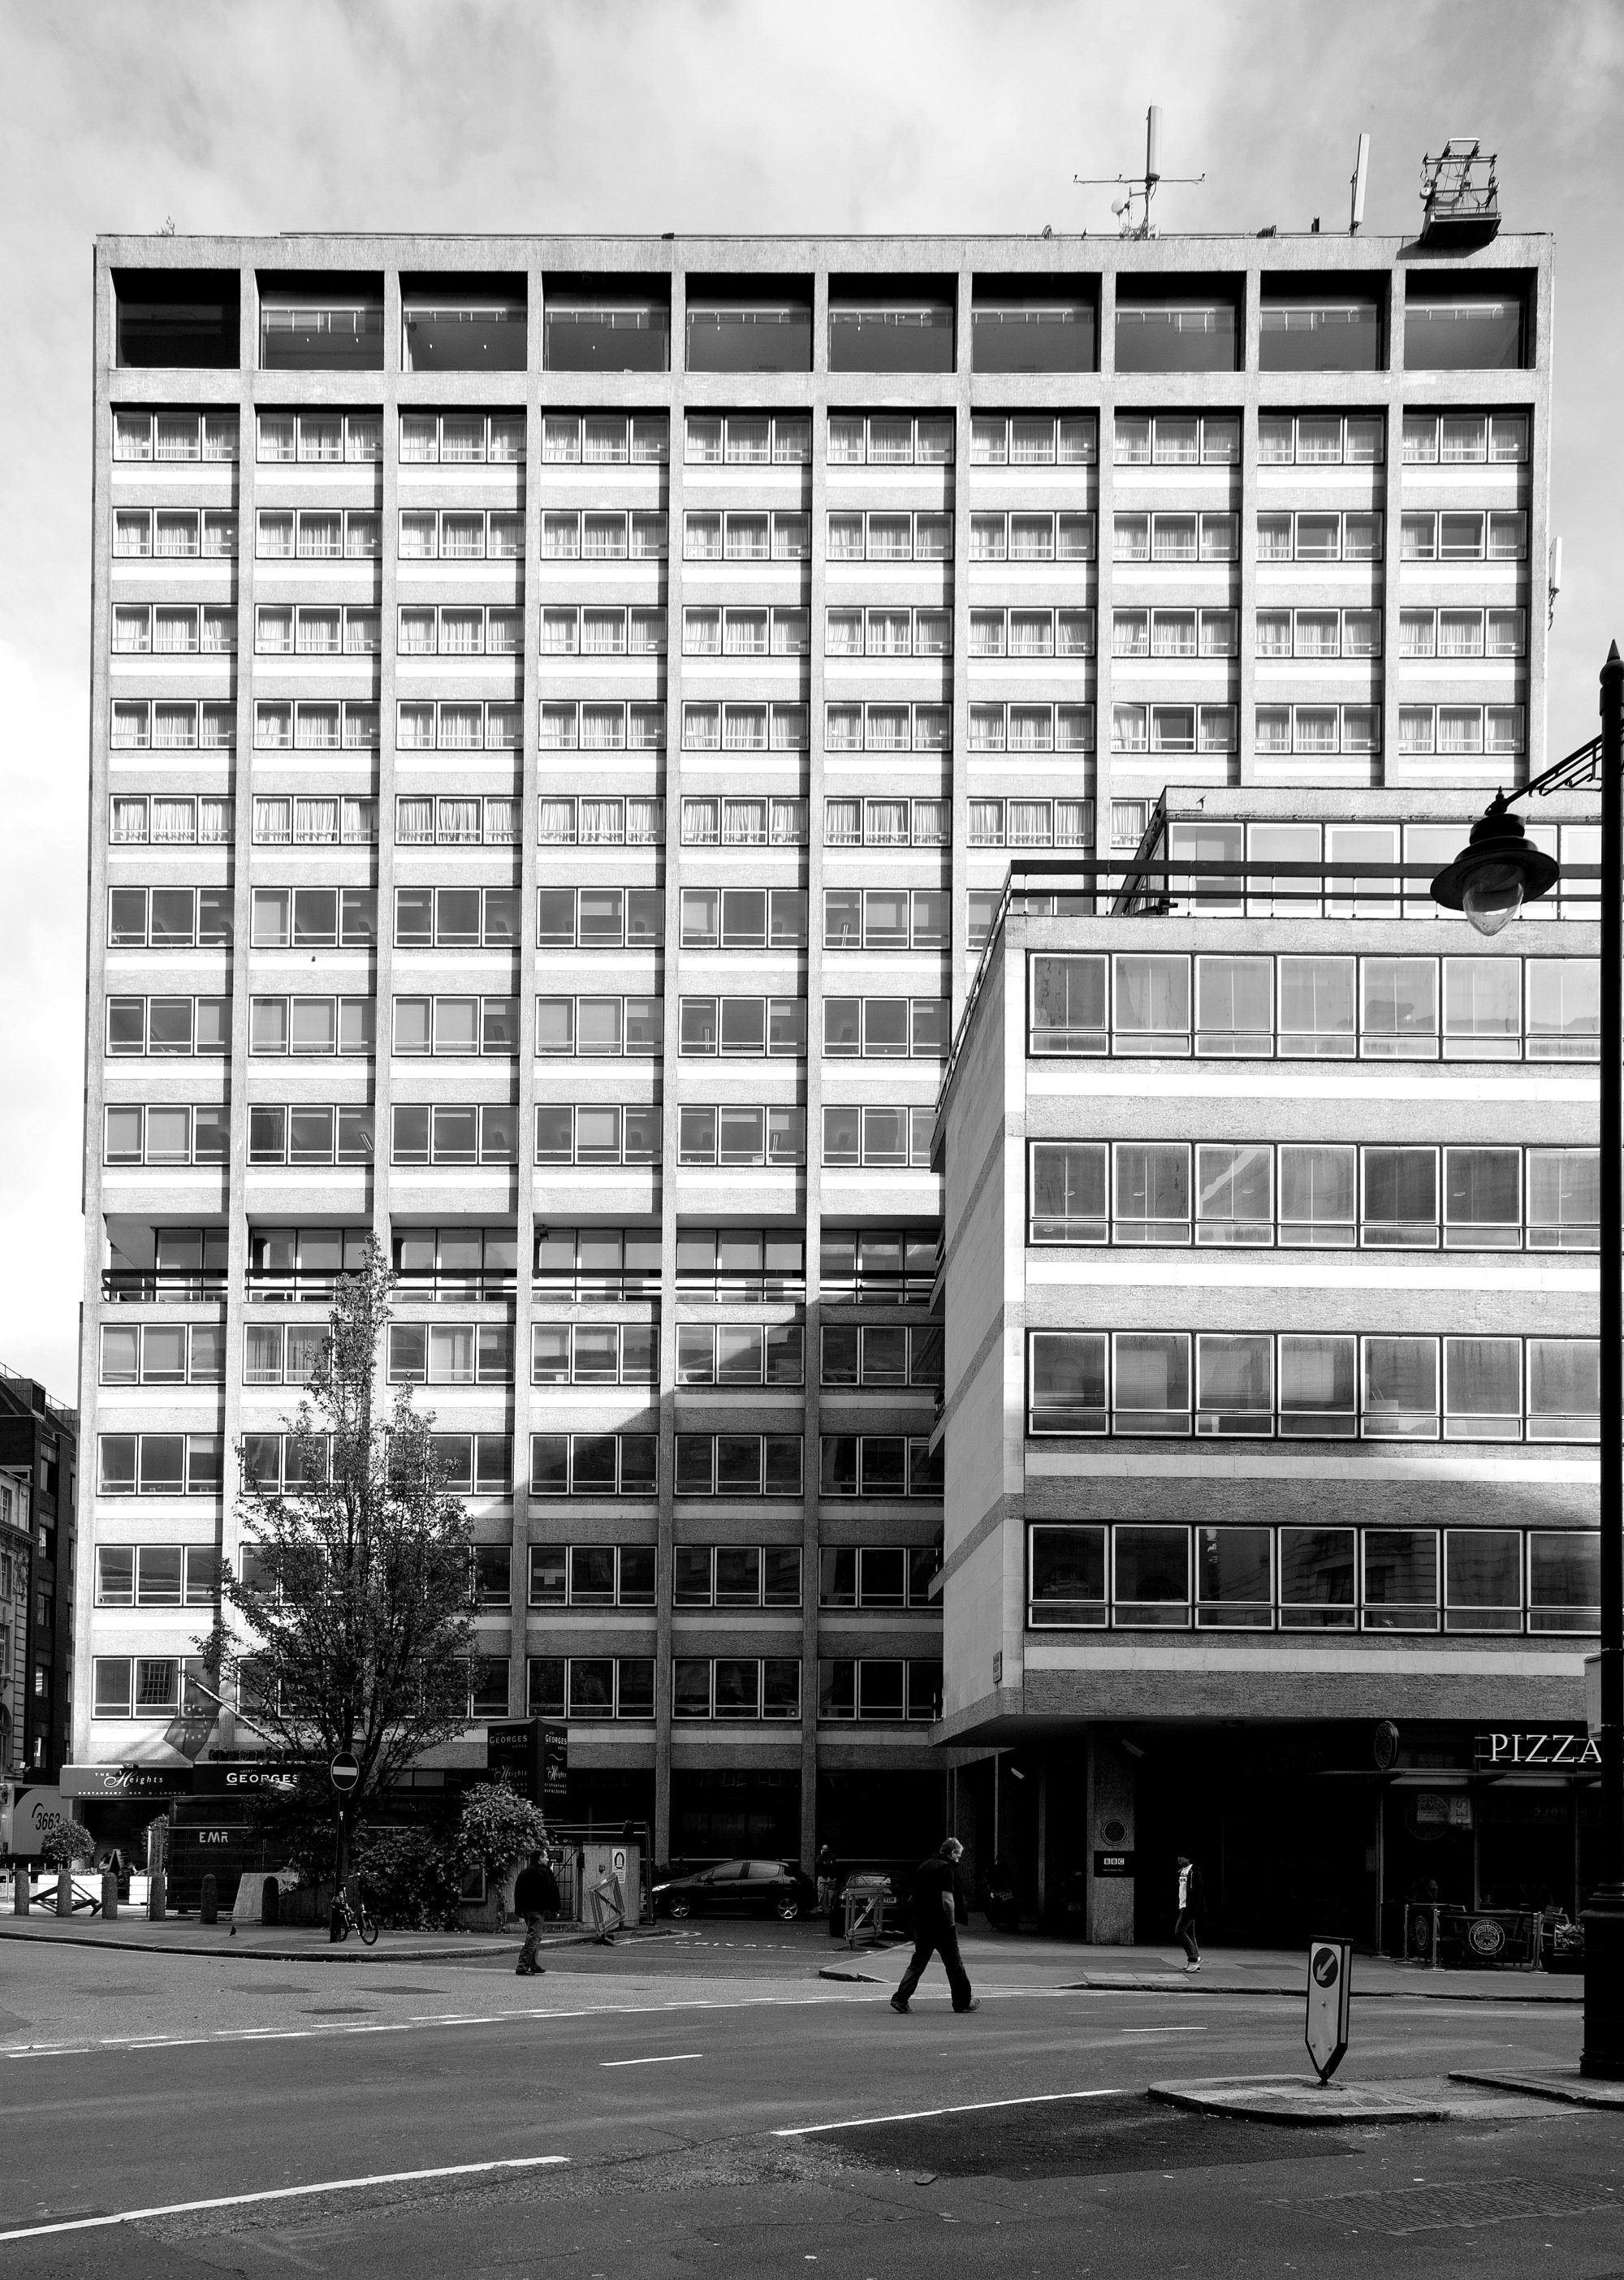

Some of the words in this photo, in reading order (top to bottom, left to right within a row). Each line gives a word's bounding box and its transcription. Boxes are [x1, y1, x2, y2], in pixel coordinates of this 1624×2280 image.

[489, 1734, 528, 1744] GEORGES
[545, 1734, 567, 1745] GEORGES
[1489, 1734, 1602, 1764] PIZZA
[103, 1770, 163, 1787] Heights
[226, 1773, 298, 1784] GEORGES
[36, 1812, 60, 1830] 3663
[199, 1831, 228, 1842] EMR
